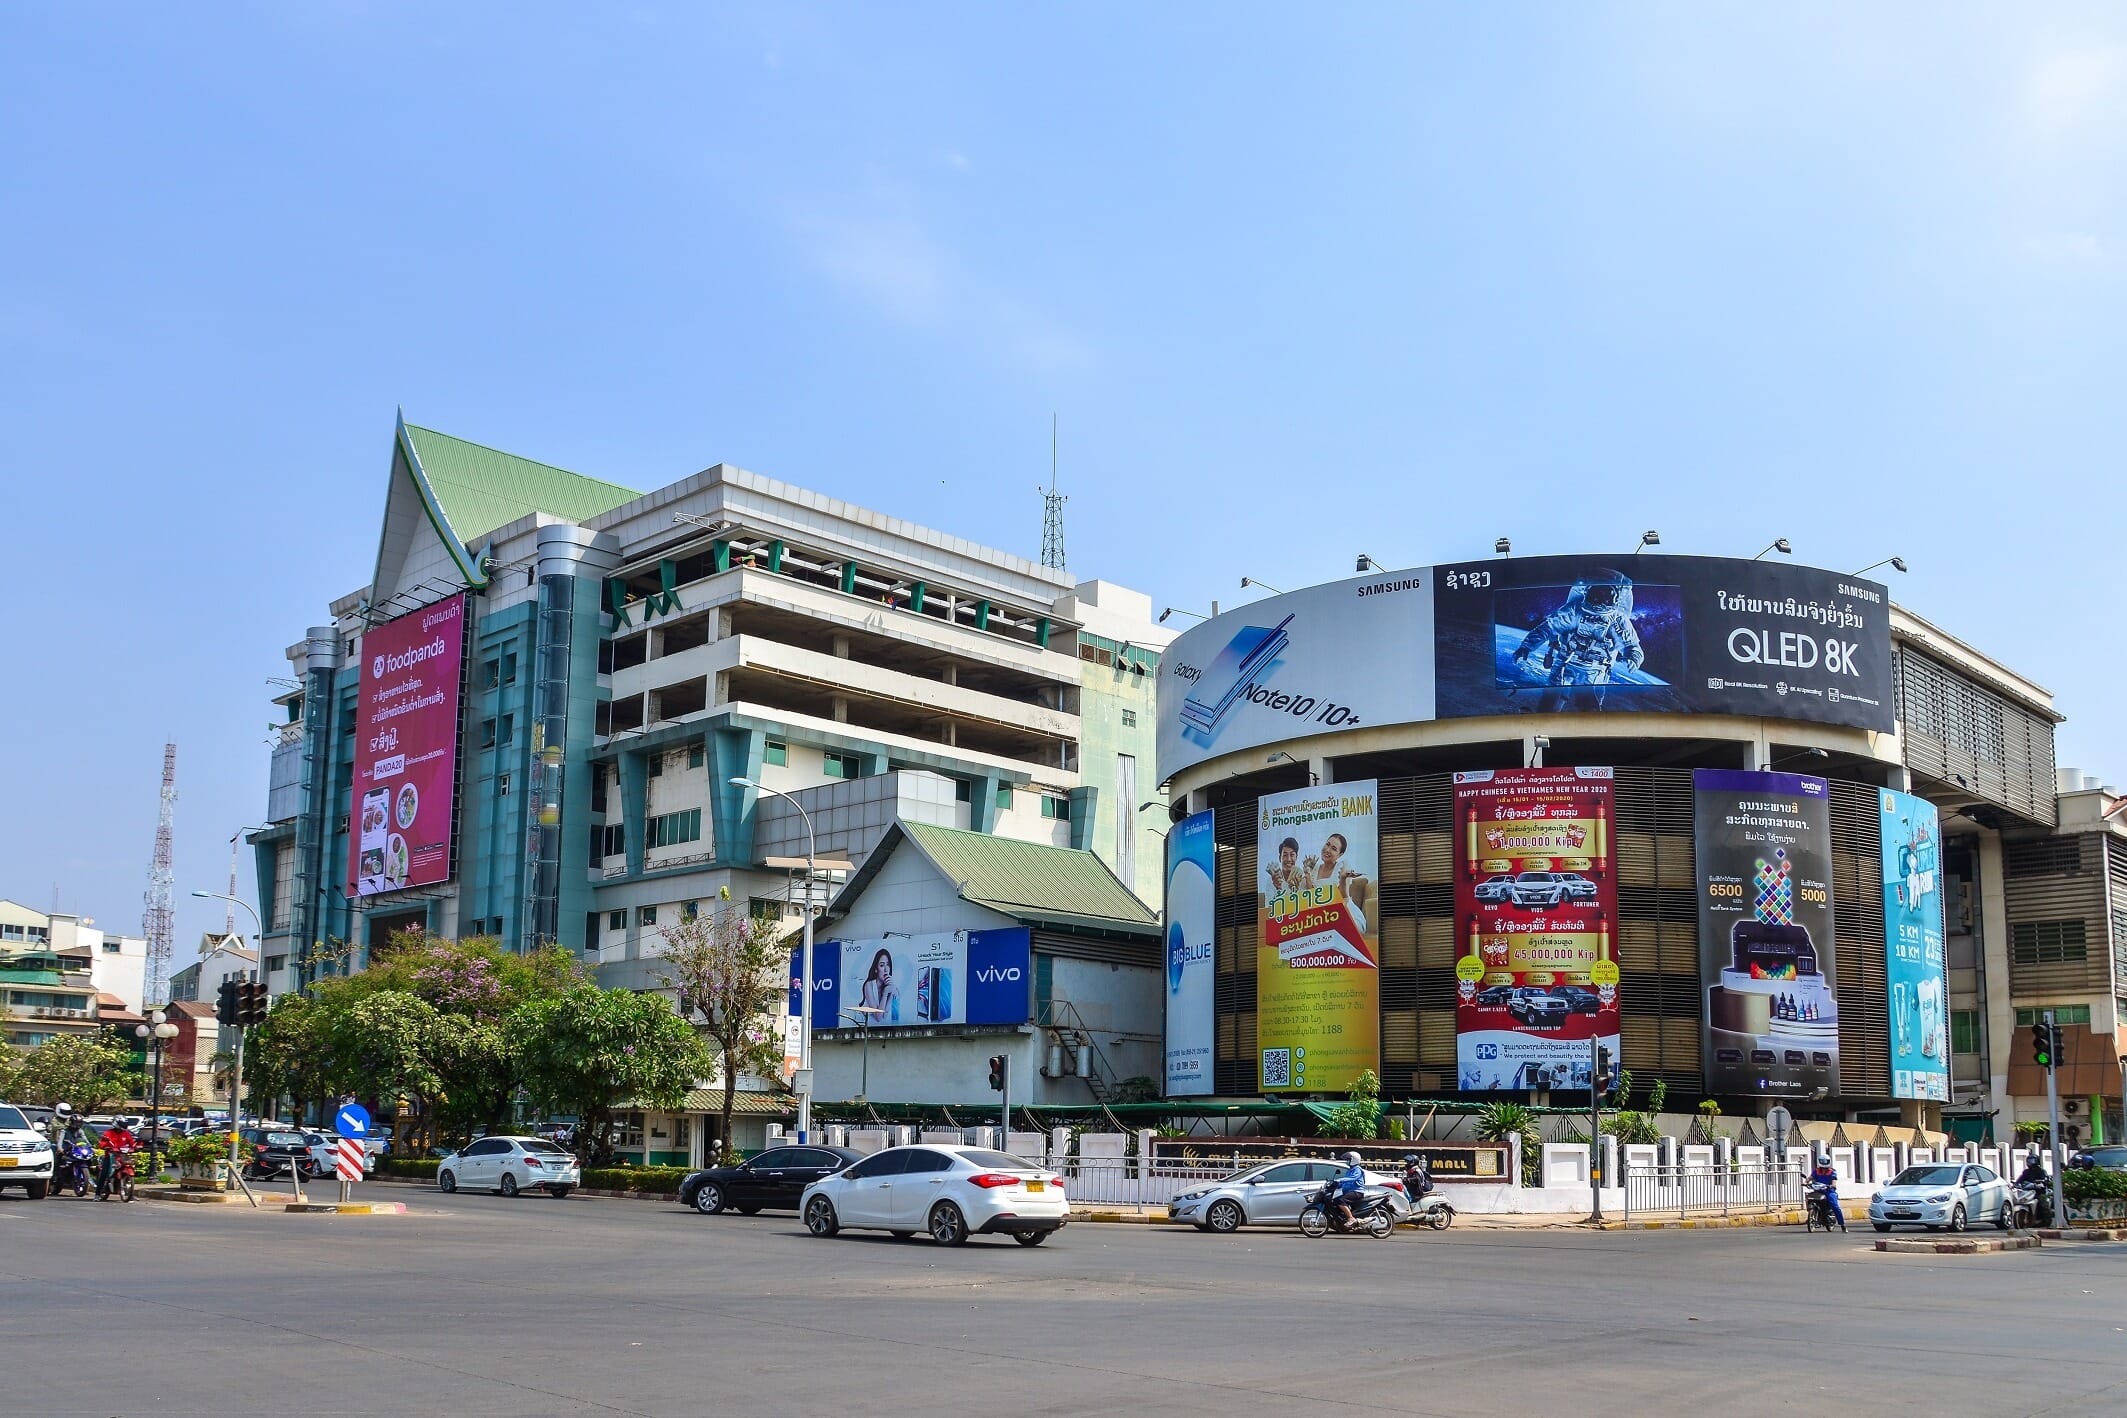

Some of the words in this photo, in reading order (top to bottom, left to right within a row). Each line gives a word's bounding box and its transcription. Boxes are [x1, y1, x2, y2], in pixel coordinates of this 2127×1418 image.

[1358, 578, 1420, 597] SAMSUNG
[1838, 583, 1880, 604] SAMSUNG
[387, 636, 445, 673] foodpanda
[1727, 627, 1818, 668] QLED
[1825, 639, 1859, 677] 8K
[1174, 662, 1202, 687] Galaxy
[375, 759, 403, 776] PANDA20
[1458, 789, 1479, 797] HAPPY
[1556, 786, 1570, 794] NEW
[1341, 795, 1373, 817] BANK
[1273, 809, 1339, 828] Phongsavanh
[1499, 836, 1551, 850] 1,000,000
[1555, 836, 1573, 849] Kip
[1709, 884, 1743, 897] 6500
[1801, 888, 1826, 902] 5000
[1899, 924, 1905, 937] 5
[1907, 925, 1919, 939] KM
[845, 944, 862, 953] vivo
[931, 943, 941, 951] S1
[1172, 948, 1184, 965] BIG
[1185, 942, 1211, 961] BLUE
[1895, 944, 1906, 957] 10
[1908, 945, 1920, 959] KM
[1291, 955, 1345, 969] 500,000,000
[1514, 949, 1573, 961] 45,000,000
[1578, 949, 1594, 961] Kip
[976, 964, 1021, 983] vivo
[1322, 1024, 1343, 1034] 1188
[1476, 1044, 1497, 1059] PPG
[1431, 1159, 1468, 1169] MALL
